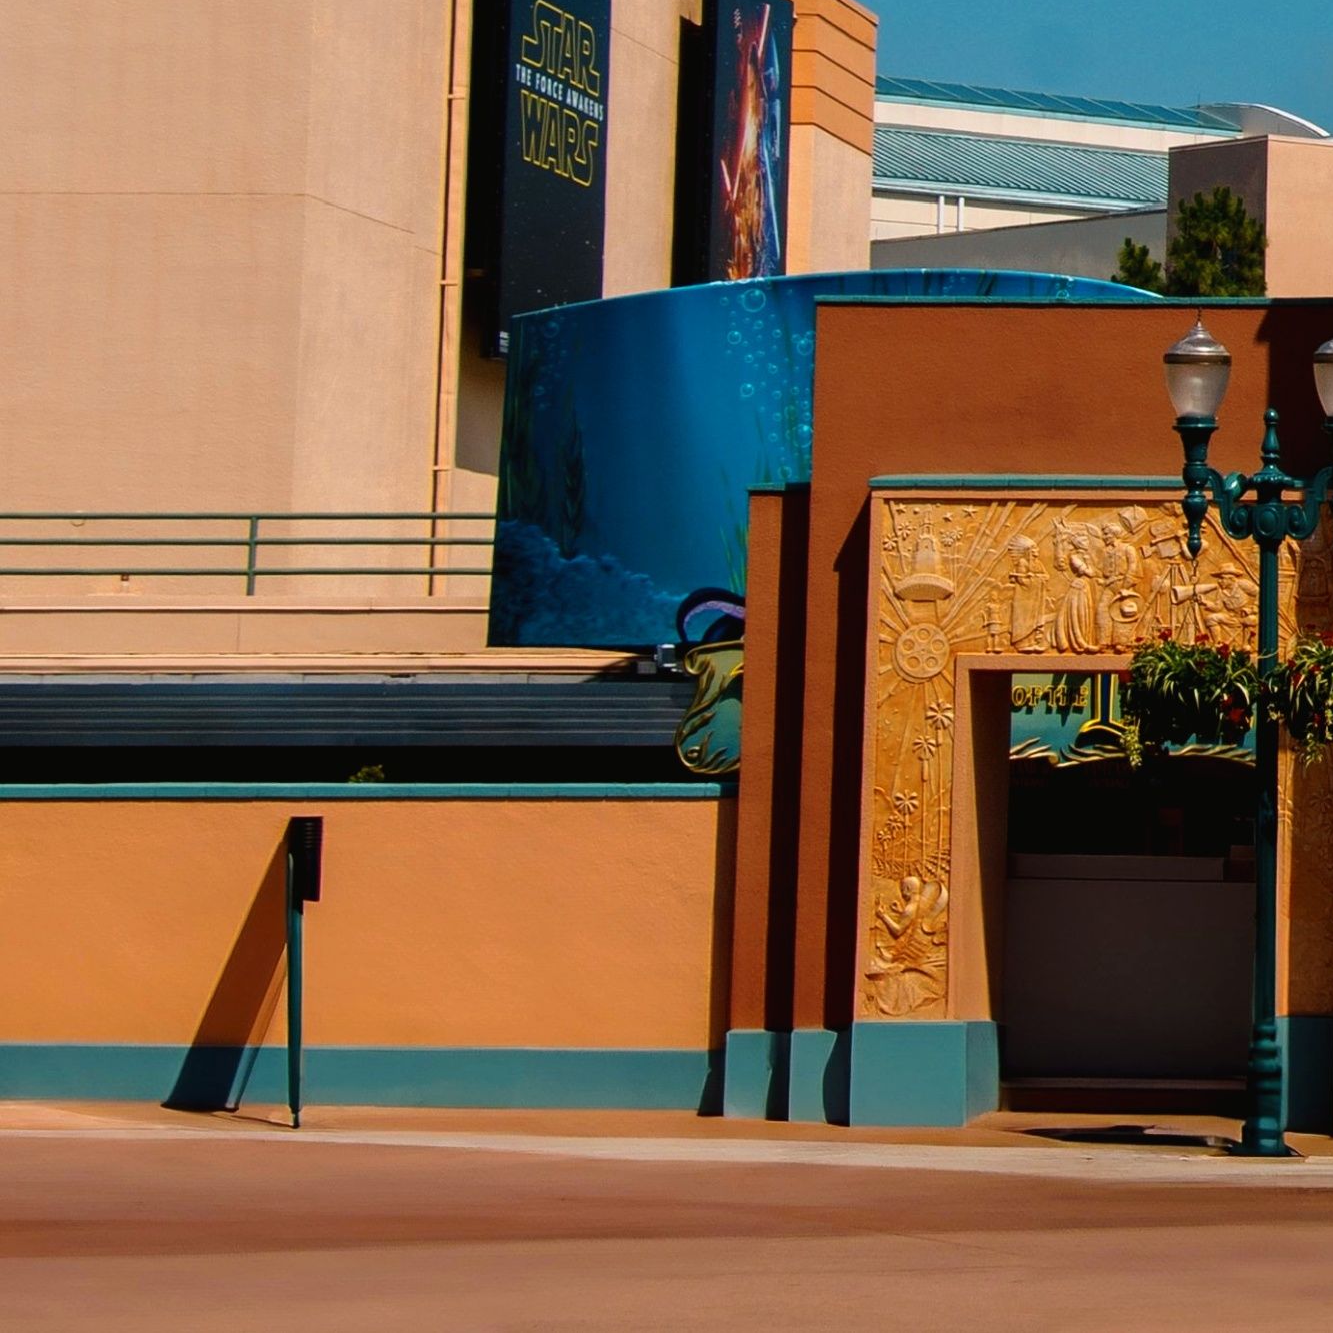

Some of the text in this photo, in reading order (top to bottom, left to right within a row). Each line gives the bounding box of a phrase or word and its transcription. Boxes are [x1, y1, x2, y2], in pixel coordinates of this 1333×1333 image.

[515, 63, 604, 121] THE FORCE AWAKENS
[521, 0, 600, 97] STAR
[520, 88, 600, 187] WARS
